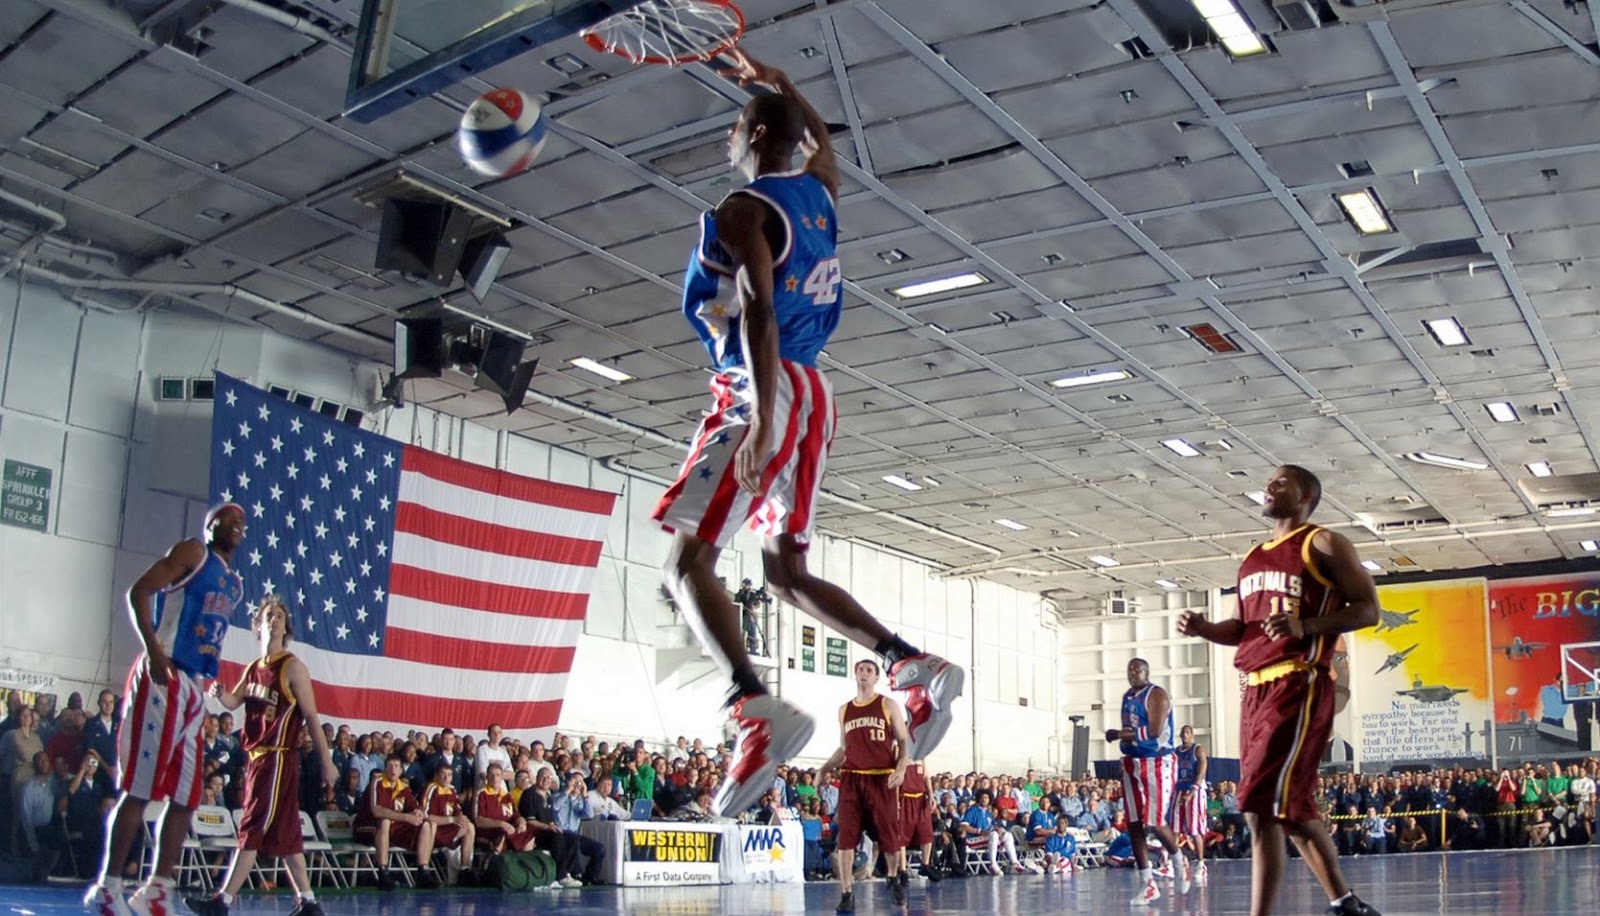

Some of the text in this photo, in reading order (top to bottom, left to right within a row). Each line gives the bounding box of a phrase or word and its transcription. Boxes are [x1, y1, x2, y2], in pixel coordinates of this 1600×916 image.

[803, 258, 842, 306] 42
[16, 465, 38, 479] AFFF
[7, 493, 43, 511] GROUP 3
[1532, 589, 1600, 619] BIG
[1391, 699, 1461, 711] No man needs
[1362, 708, 1459, 721] sympathy because he
[844, 716, 886, 734] NATIONALS
[1362, 716, 1458, 729] has to work. Far and
[870, 728, 886, 742] 10
[1365, 726, 1456, 739] away the best prize
[1363, 733, 1464, 747] that life offers is the
[1509, 736, 1522, 751] 71
[1362, 743, 1441, 754] chance to work
[1363, 753, 1382, 762] hard
[1385, 752, 1396, 761] at
[1397, 750, 1422, 760] work
[1425, 749, 1454, 759] worth
[394, 797, 405, 811] N
[501, 803, 514, 817] N
[632, 830, 707, 847] WESTERN
[744, 828, 786, 852] MWR
[656, 846, 707, 862] UNION
[636, 872, 642, 881] A
[643, 871, 661, 881] First
[663, 871, 682, 881] Data
